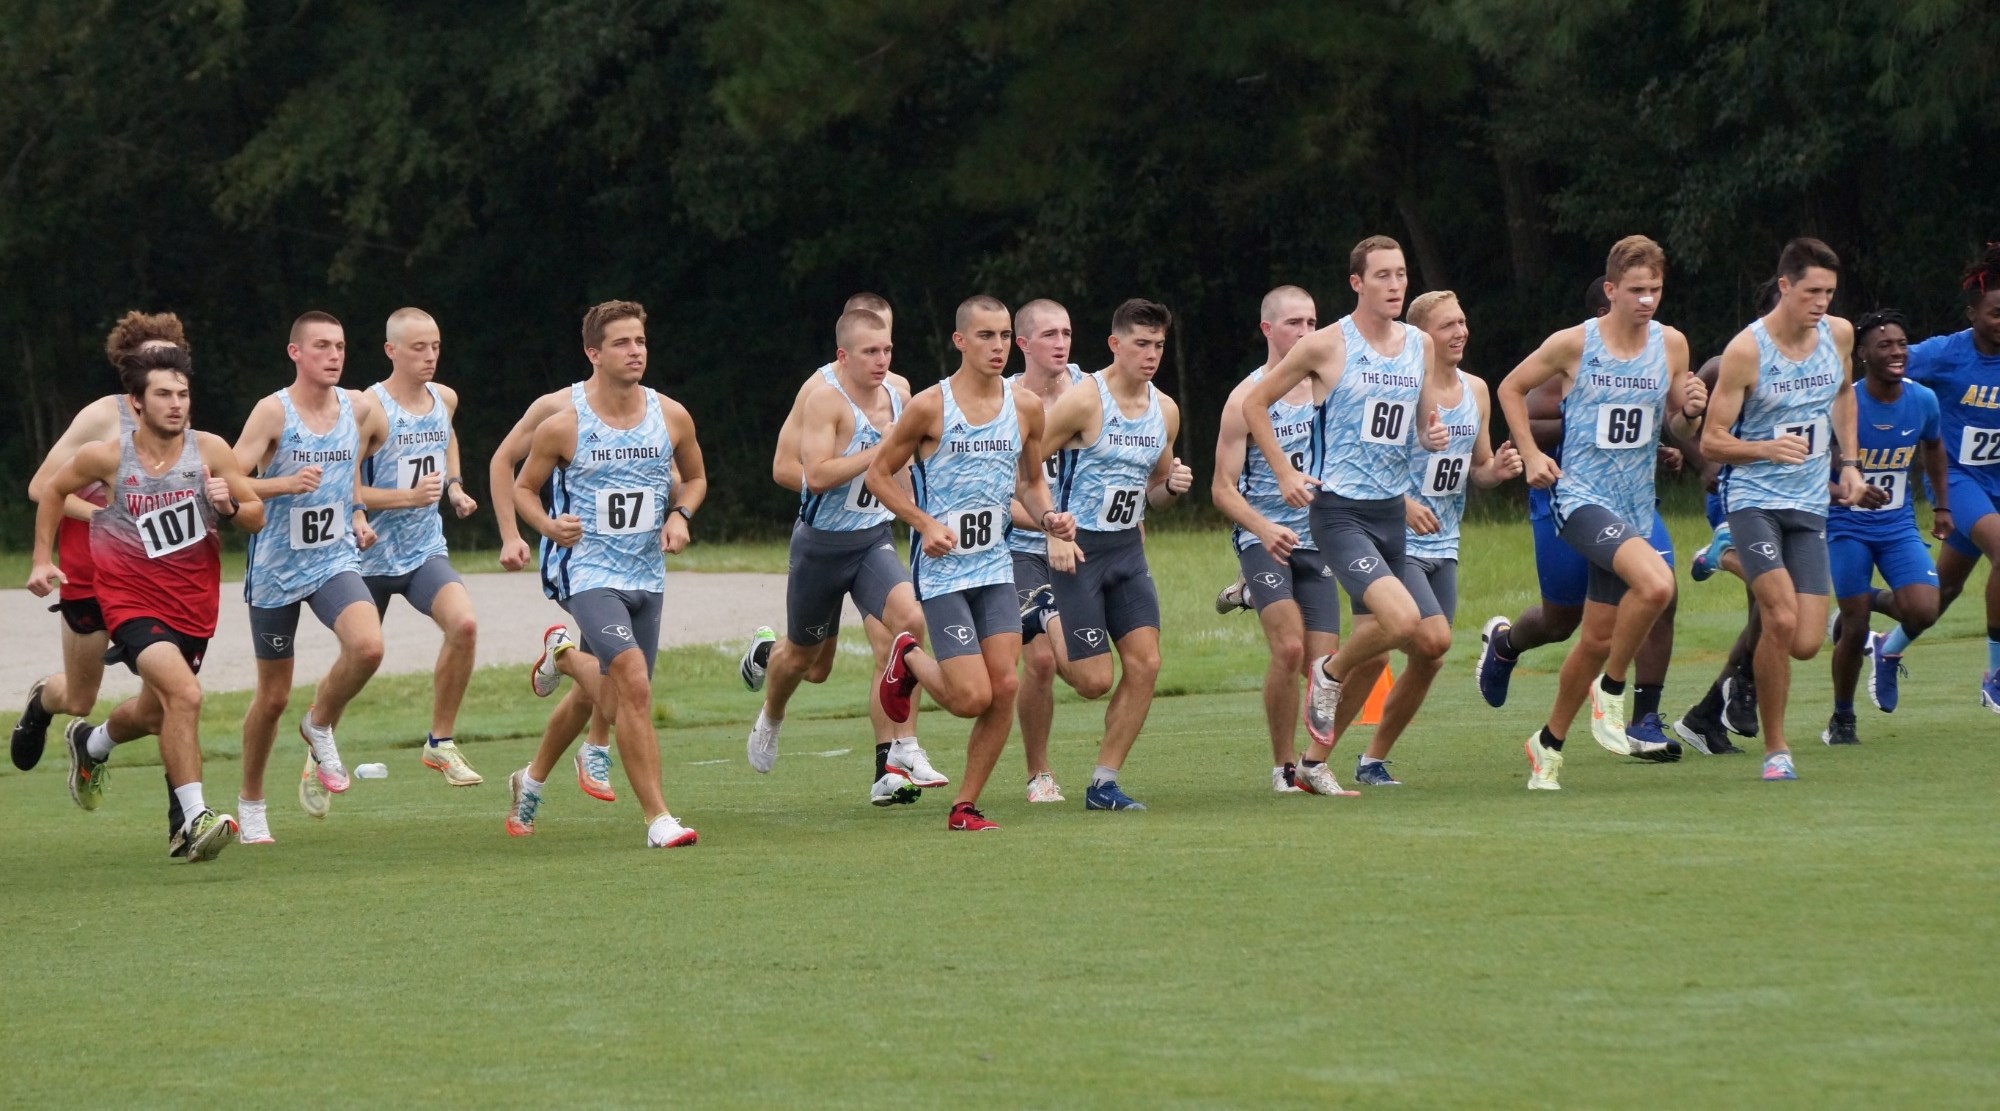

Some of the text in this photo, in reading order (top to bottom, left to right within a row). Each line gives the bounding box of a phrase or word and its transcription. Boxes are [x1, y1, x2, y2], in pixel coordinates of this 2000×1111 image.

[1362, 372, 1419, 388] THE CITADEL
[1591, 374, 1658, 390] THE CITADEL
[1773, 373, 1836, 393] THE CITADEL
[1960, 384, 2000, 409] ALL
[1371, 401, 1404, 440] 60
[1446, 424, 1476, 437] ITADEL
[1608, 408, 1643, 444] 69
[397, 430, 447, 445] THE CITADEL
[1108, 433, 1160, 448] THE CITADEL
[1274, 424, 1294, 438] THE
[293, 449, 352, 462] THE CITADEL
[591, 446, 660, 461] THE CITADEL
[950, 439, 1013, 453] THE CITADEL
[1432, 458, 1463, 491] 66
[608, 491, 644, 530] 67
[1106, 490, 1139, 524] 65
[141, 501, 196, 552] 107
[302, 507, 334, 544] 62
[960, 511, 992, 549] 68
